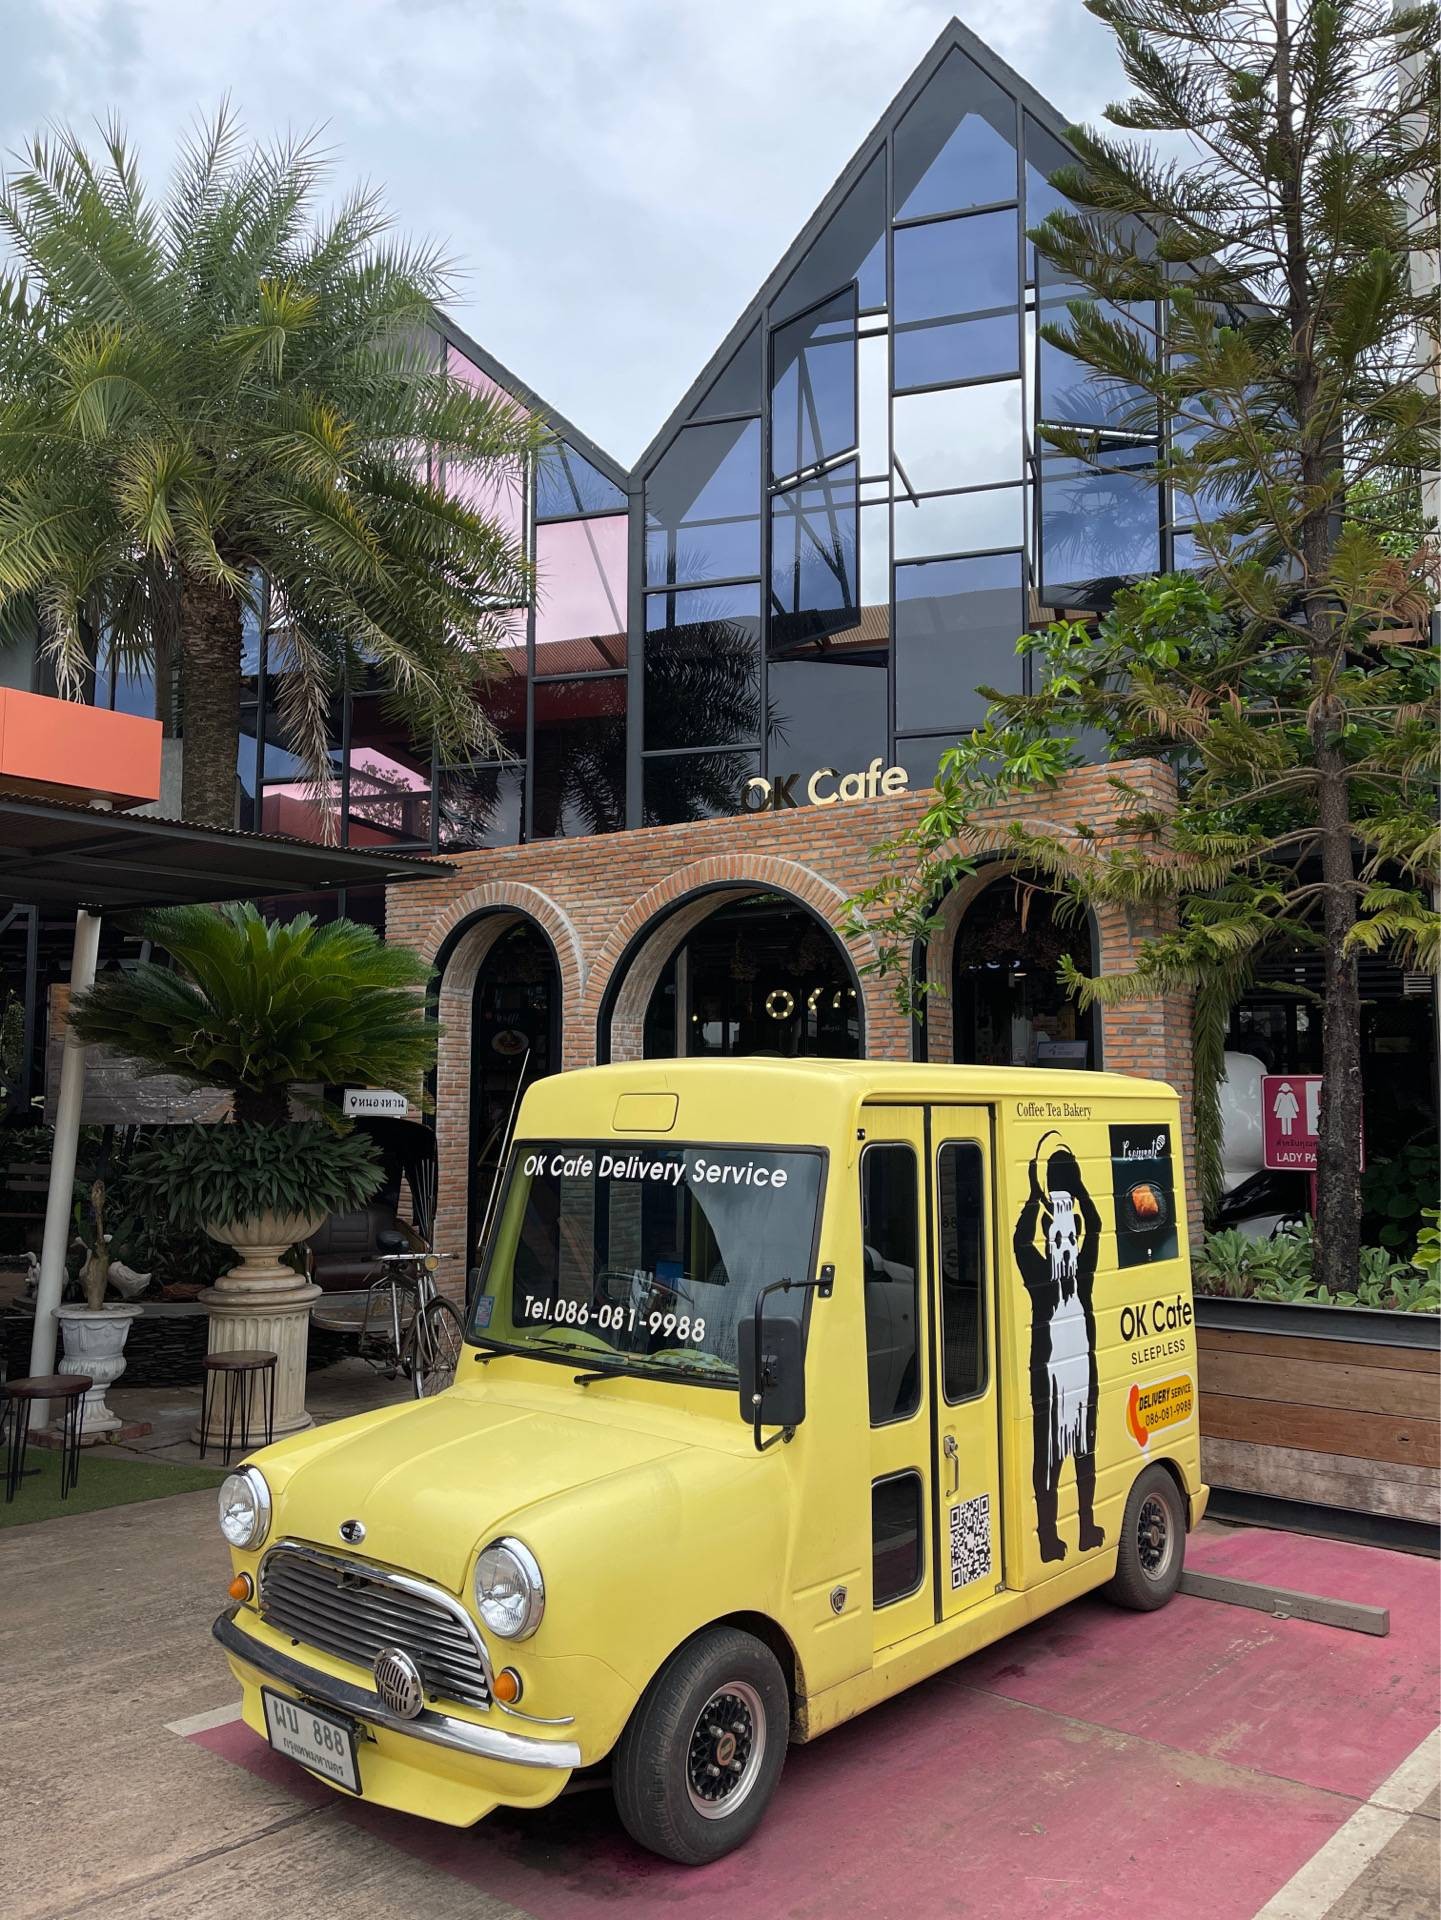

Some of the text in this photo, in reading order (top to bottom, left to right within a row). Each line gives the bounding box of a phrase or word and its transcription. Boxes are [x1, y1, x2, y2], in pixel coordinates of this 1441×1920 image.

[740, 757, 909, 813] OK Cafe
[1016, 1102, 1092, 1121] Coffee Tea Bakery
[523, 1154, 789, 1189] OK Cafe Delivery Service
[1276, 1152, 1303, 1163] LADY
[523, 1294, 706, 1343] Tel.086-081-9988
[1120, 1294, 1192, 1342] OK Cafe
[1131, 1338, 1186, 1366] SLEEPLESS
[1138, 1383, 1191, 1412] DELIVERY SERVICE
[312, 1719, 345, 1757] 888
